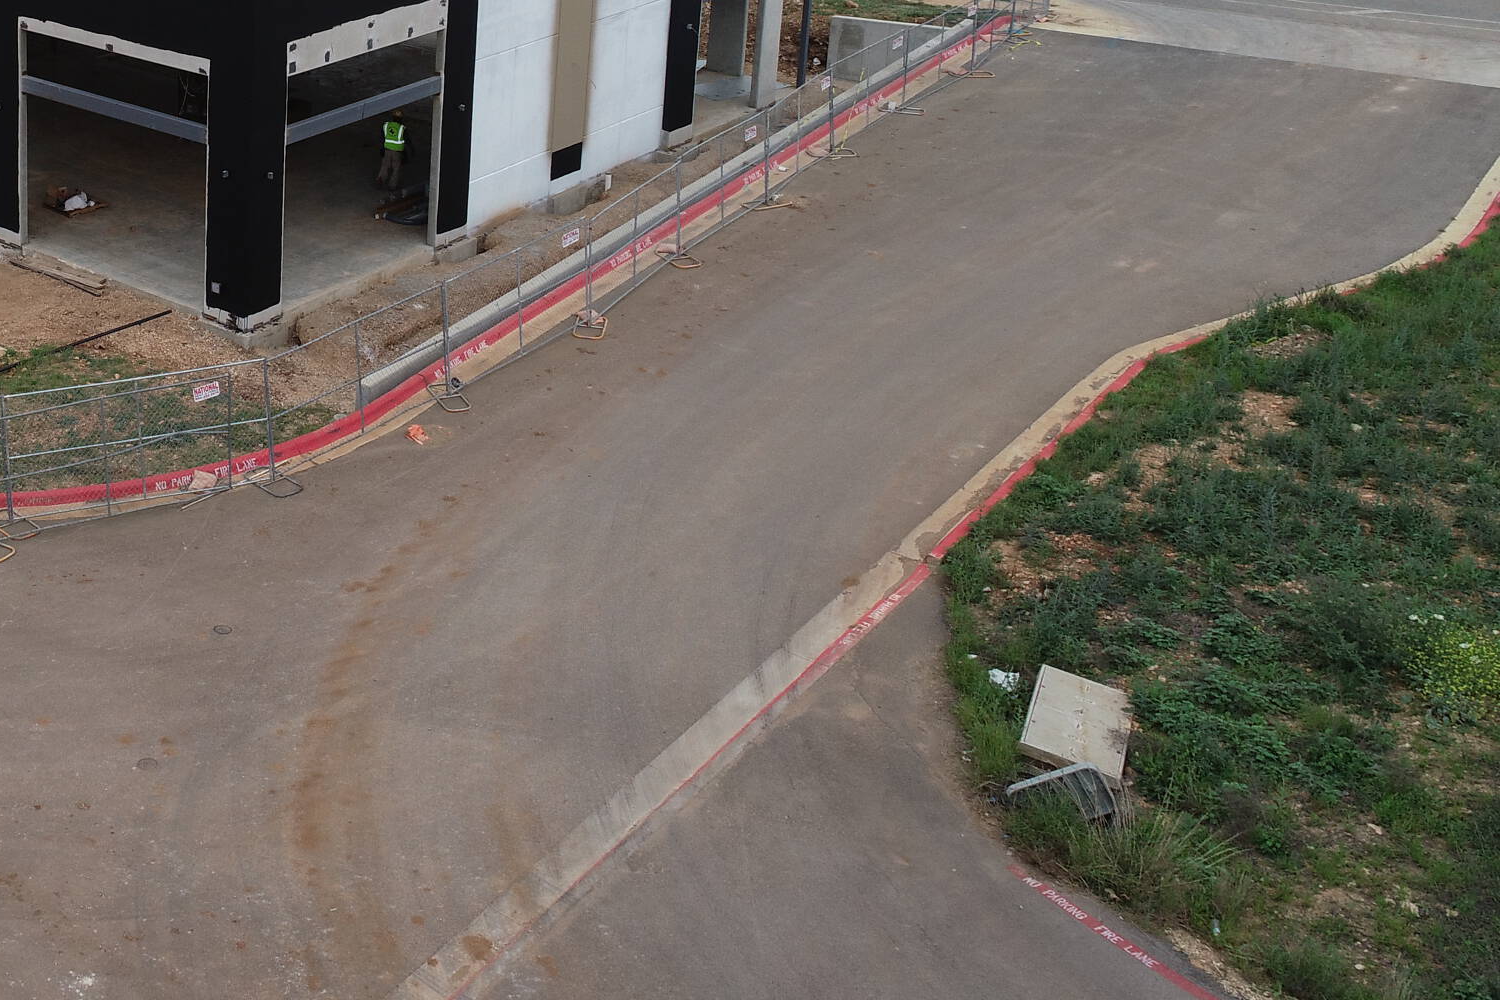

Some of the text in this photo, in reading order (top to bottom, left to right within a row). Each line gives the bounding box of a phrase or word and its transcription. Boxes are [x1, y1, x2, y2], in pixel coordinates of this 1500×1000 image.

[155, 481, 167, 491] NO
[171, 474, 194, 488] PARK
[236, 458, 257, 472] LANE
[1022, 877, 1160, 968] NO PARKING FIRE LANE
